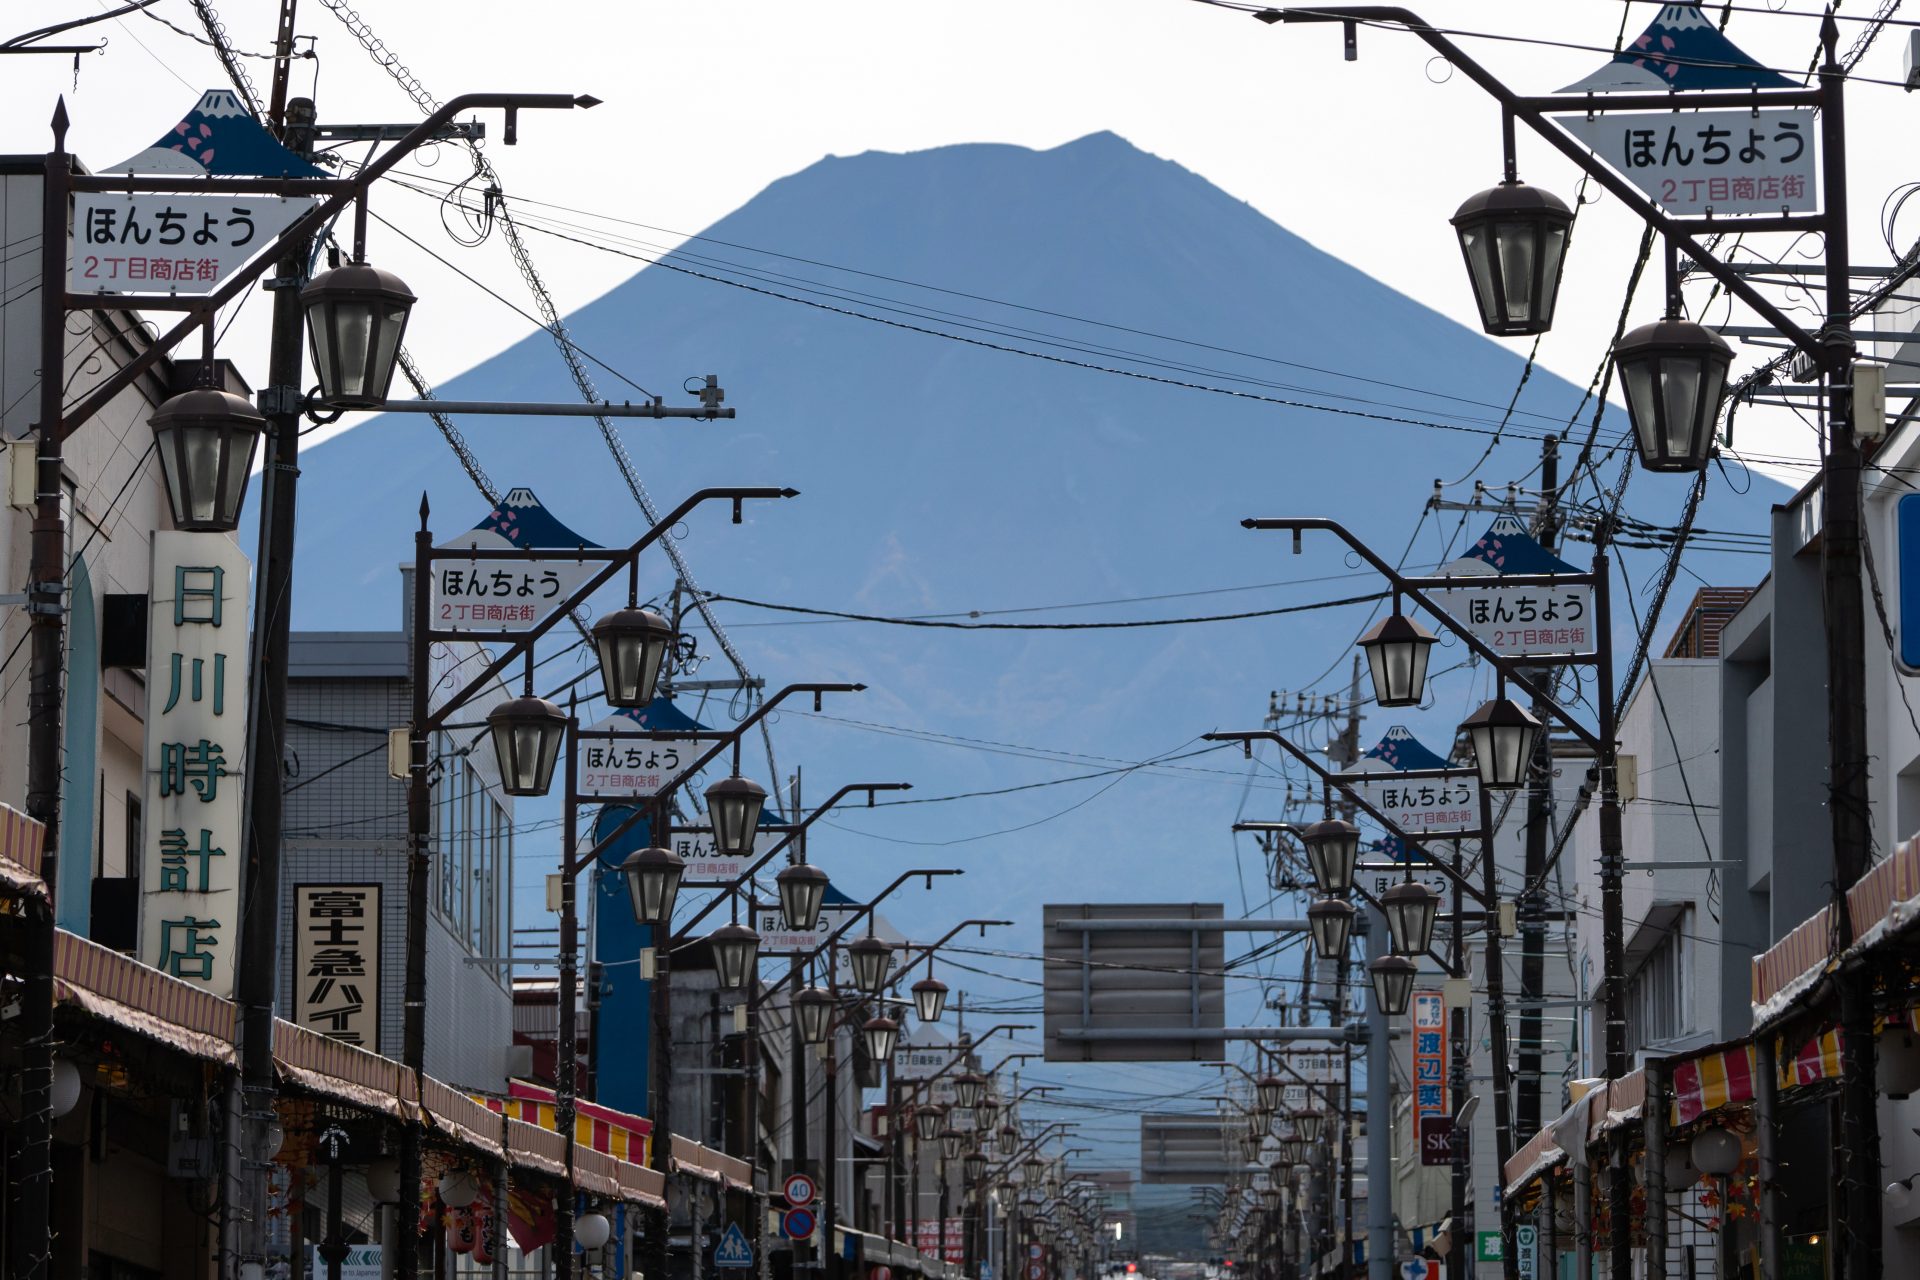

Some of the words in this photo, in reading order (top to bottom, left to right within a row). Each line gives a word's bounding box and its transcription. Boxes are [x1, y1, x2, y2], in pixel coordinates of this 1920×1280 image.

[1624, 122, 1805, 168] ほんちょう
[1661, 175, 1806, 202] 2丁目商店街
[86, 206, 255, 247] ほんちょう
[84, 256, 219, 282] 2丁目商店街
[442, 569, 560, 598] ほんちょう
[441, 604, 536, 621] 2丁目商店街
[1469, 594, 1584, 624] ほんちょう
[1494, 628, 1585, 647] 2丁目商店街
[586, 747, 680, 770] ほんちょう
[157, 564, 227, 981] 日川時計店
[586, 774, 660, 788] 2丁目商店街
[1382, 784, 1471, 809] ほんちょう
[1402, 810, 1472, 826] 2丁目商店街
[676, 840, 755, 858] ほんち
[687, 863, 739, 874] 丁目商店街
[763, 916, 830, 933] ほんう
[791, 1182, 809, 1198] 40
